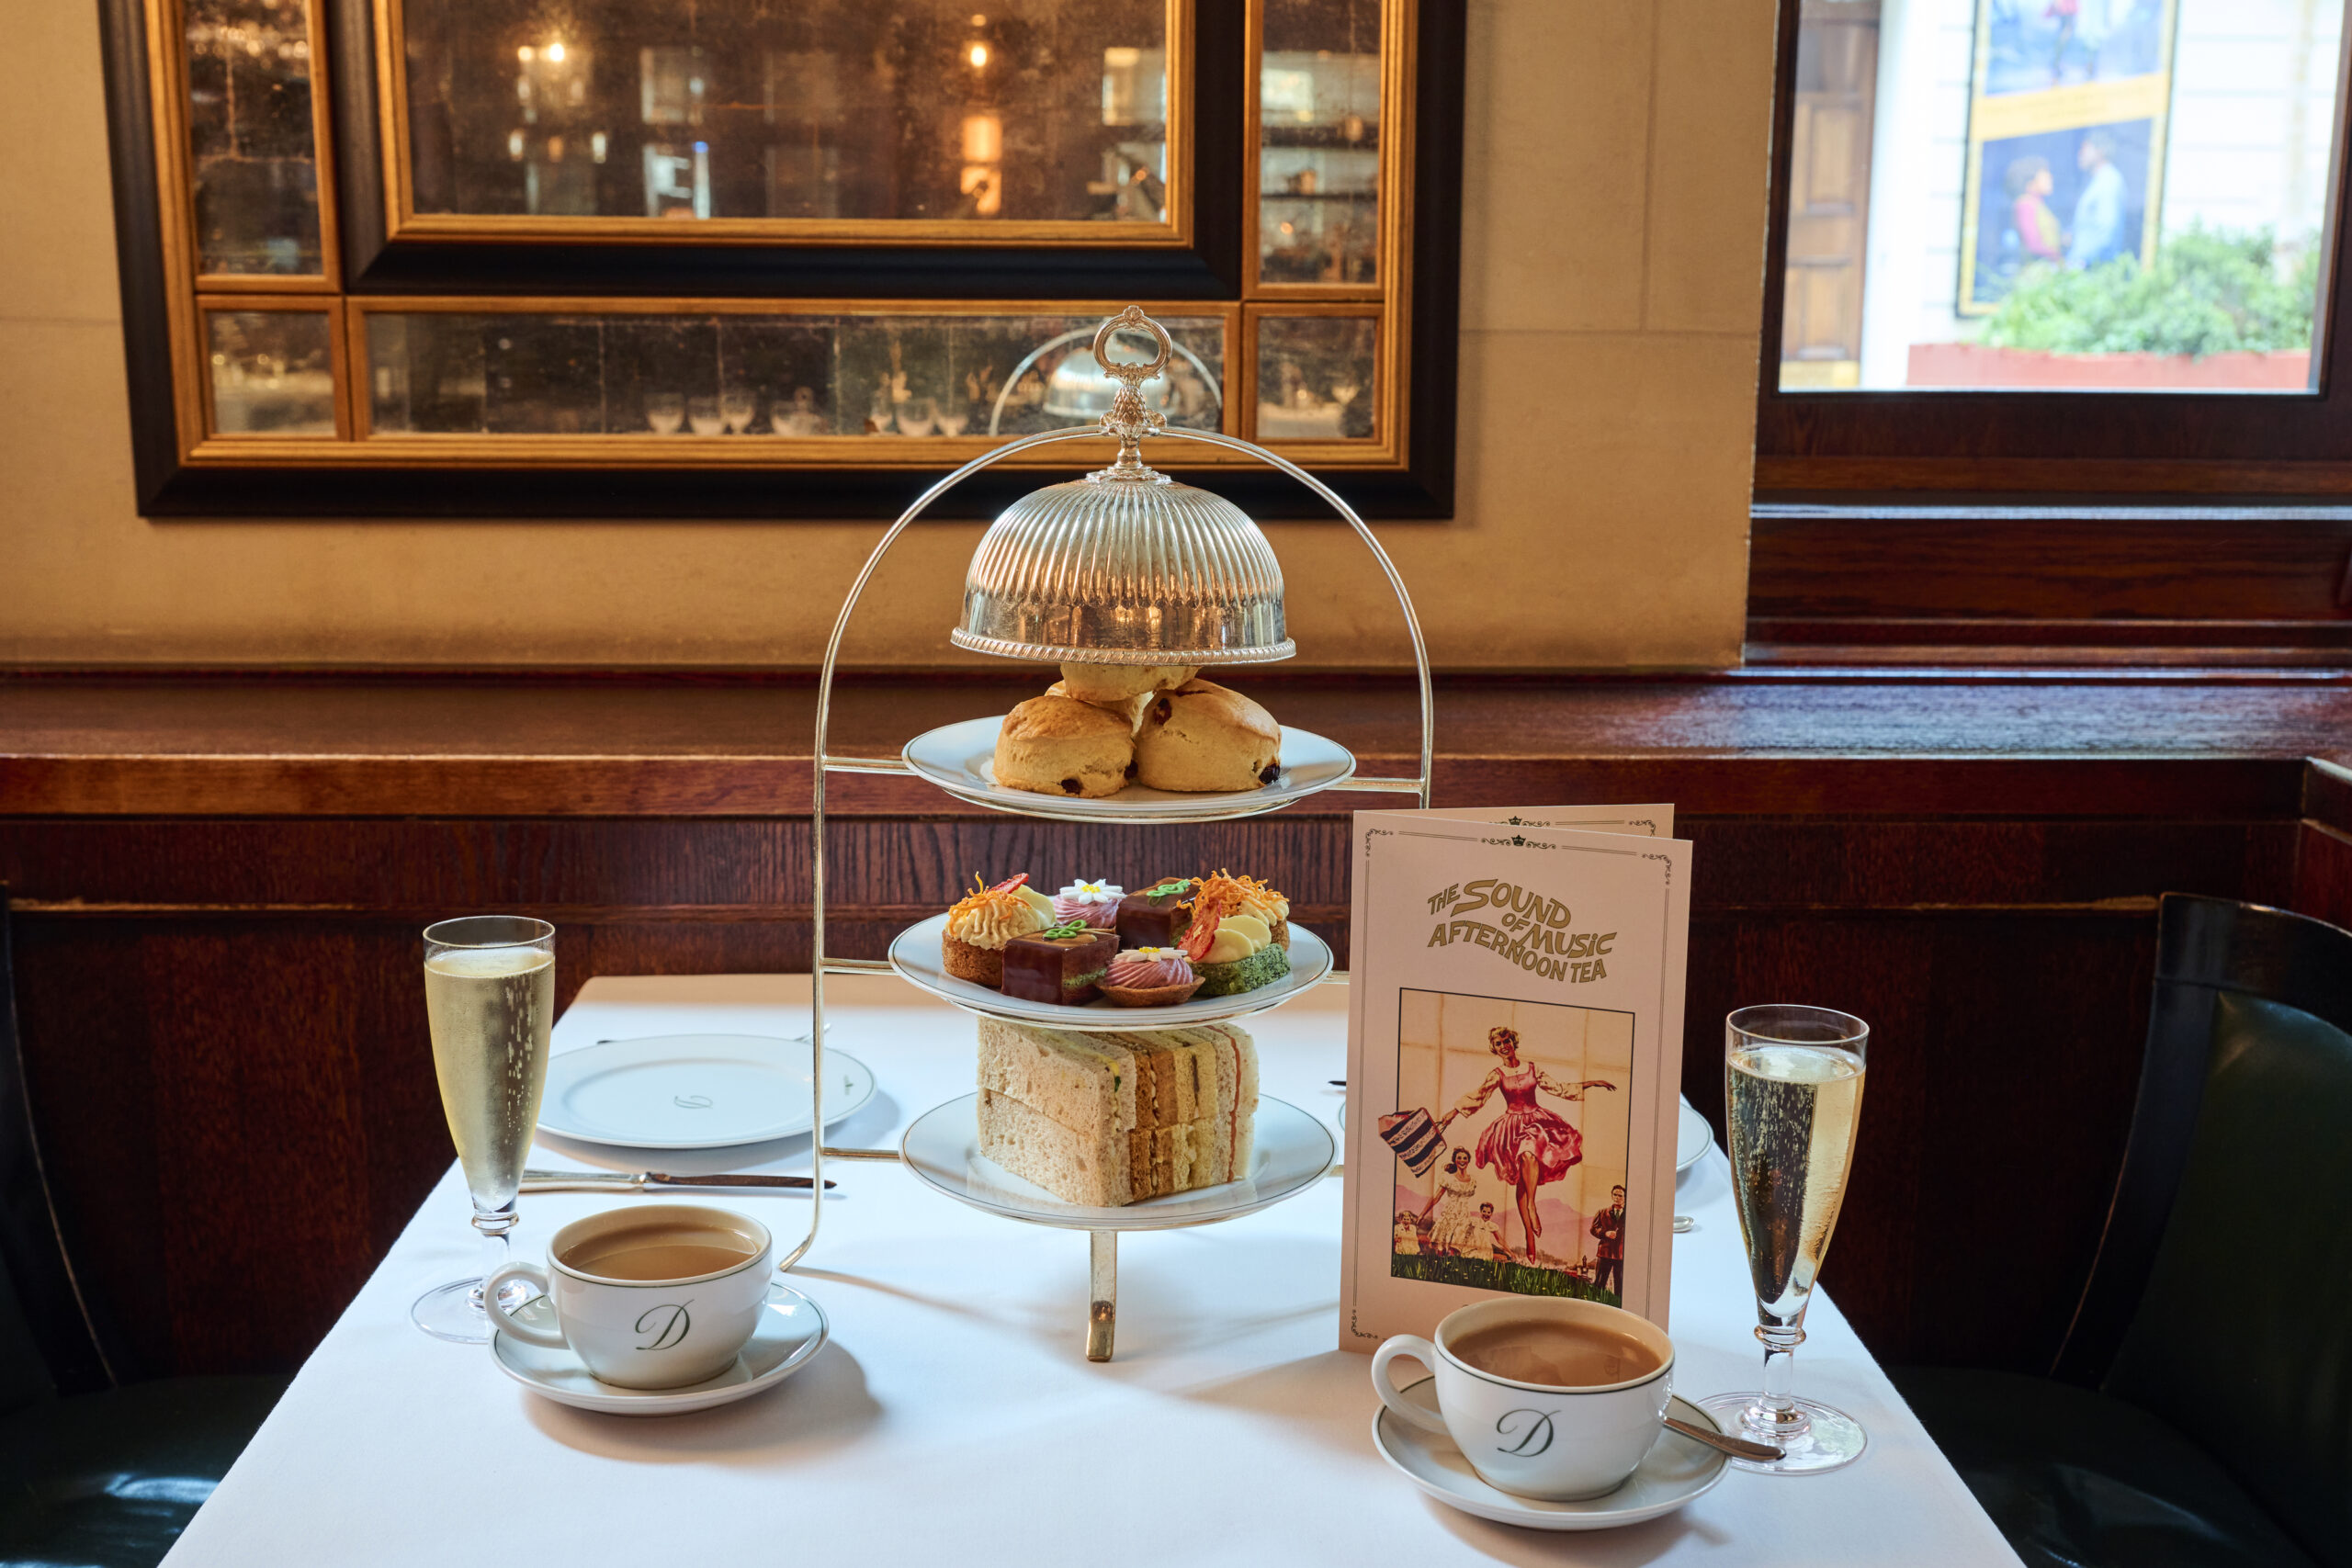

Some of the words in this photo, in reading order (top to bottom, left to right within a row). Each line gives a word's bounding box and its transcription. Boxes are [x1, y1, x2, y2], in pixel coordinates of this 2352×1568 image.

[1427, 883, 1461, 915] THE
[1451, 879, 1571, 929] SOUND
[1501, 913, 1532, 932] OF
[1427, 920, 1567, 982] AFTERNOON
[1570, 958, 1607, 983] TEA
[635, 1299, 695, 1351] D
[1496, 1408, 1562, 1458] D
